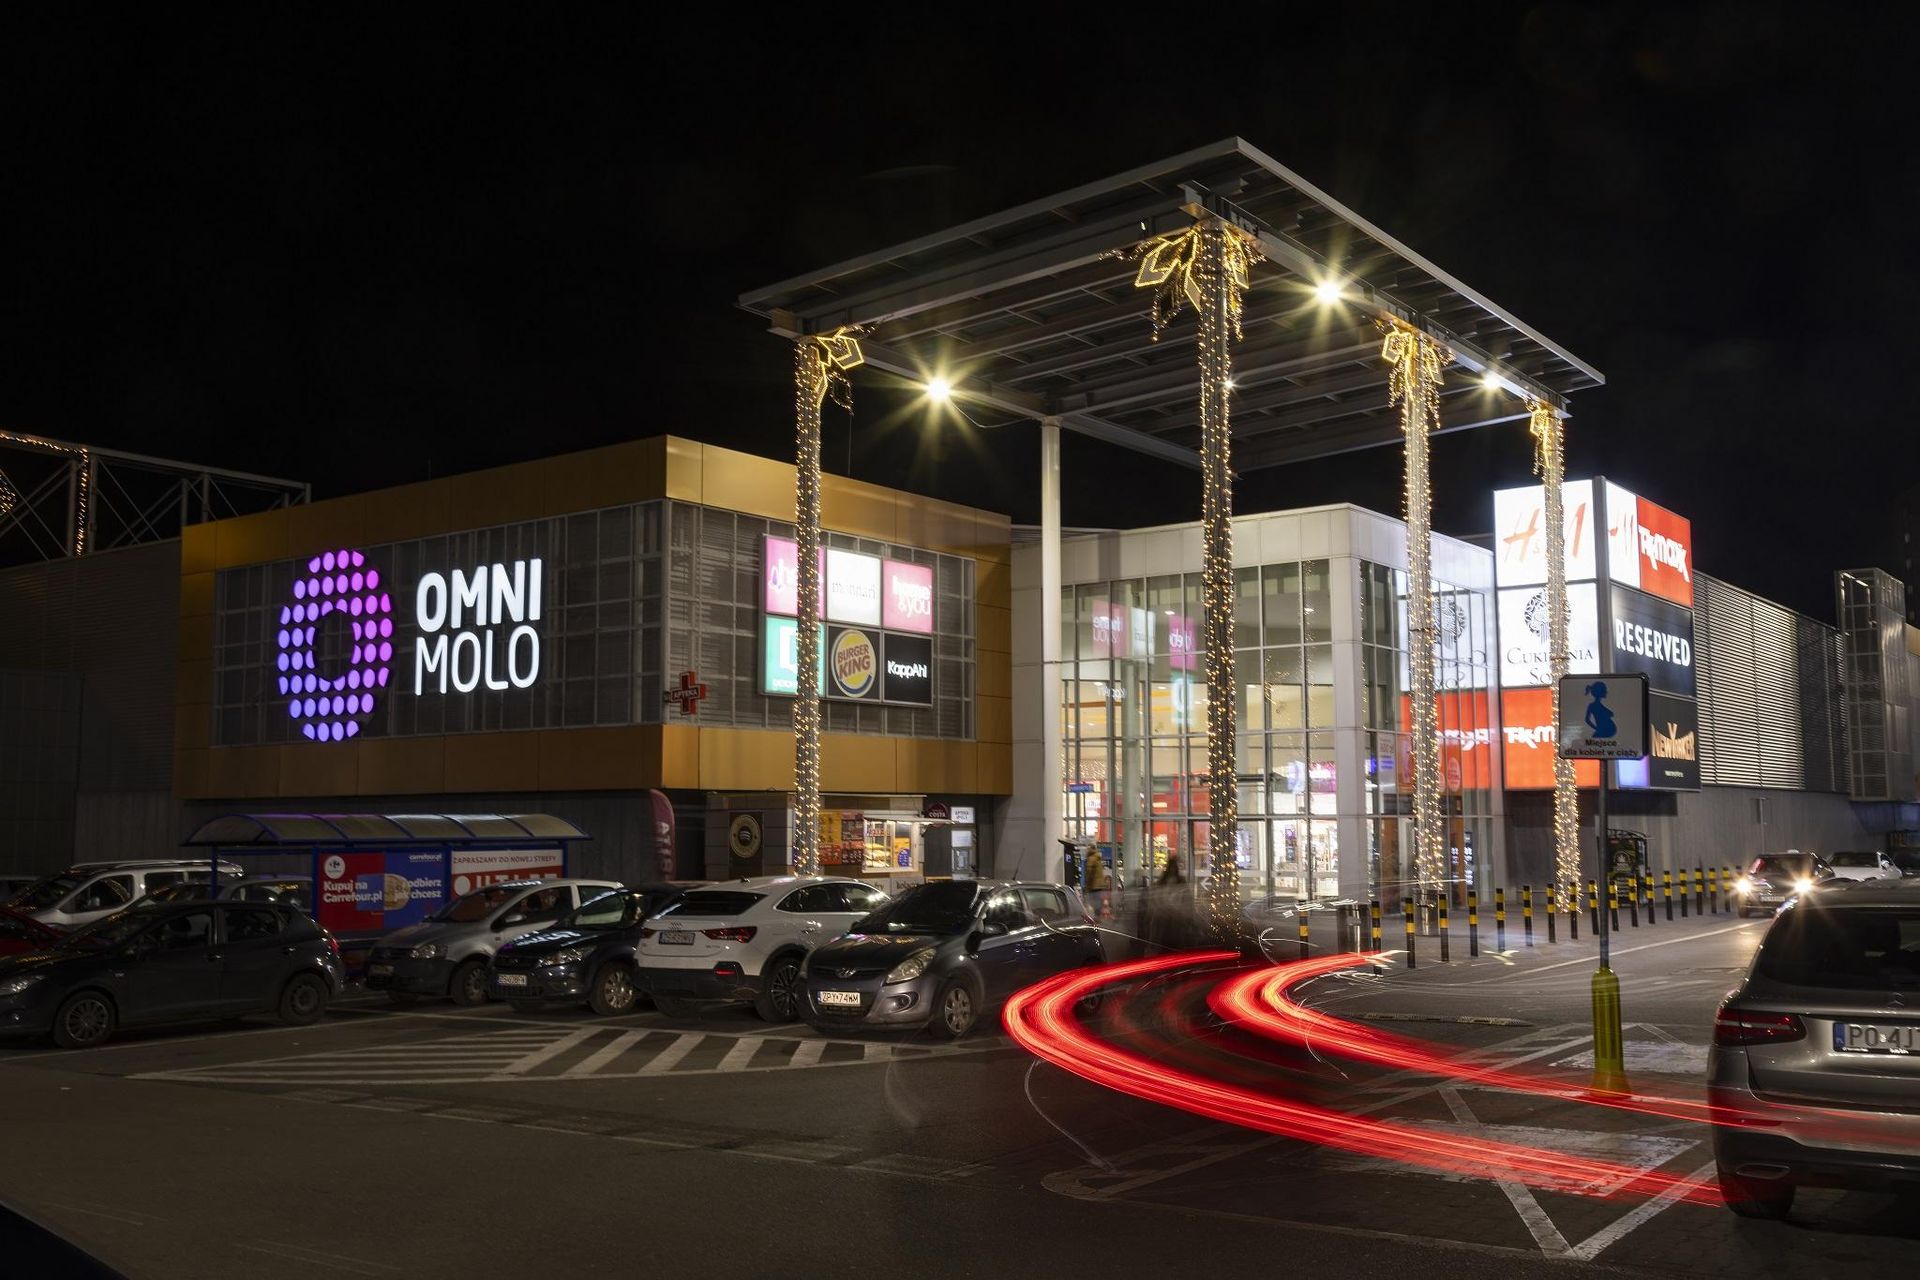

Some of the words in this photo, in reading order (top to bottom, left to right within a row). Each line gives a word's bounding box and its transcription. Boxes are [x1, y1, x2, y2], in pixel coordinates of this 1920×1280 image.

[415, 558, 542, 633] OMNI
[897, 594, 931, 618] &you
[1615, 618, 1691, 667] RESERVED
[415, 625, 541, 696] MOLO
[838, 643, 870, 664] BURGER
[1506, 647, 1594, 665] CUKINIA
[838, 655, 871, 679] KING
[887, 660, 928, 679] KappAhl
[1584, 739, 1617, 748] Miejsce
[453, 856, 498, 864] ZAPRASZAMY
[534, 855, 557, 863] STREFY
[323, 880, 354, 894] Kupuj
[355, 881, 368, 891] na
[411, 889, 442, 899] chcesz
[323, 890, 383, 904] Carrefour.pl
[822, 992, 836, 1002] ZPY
